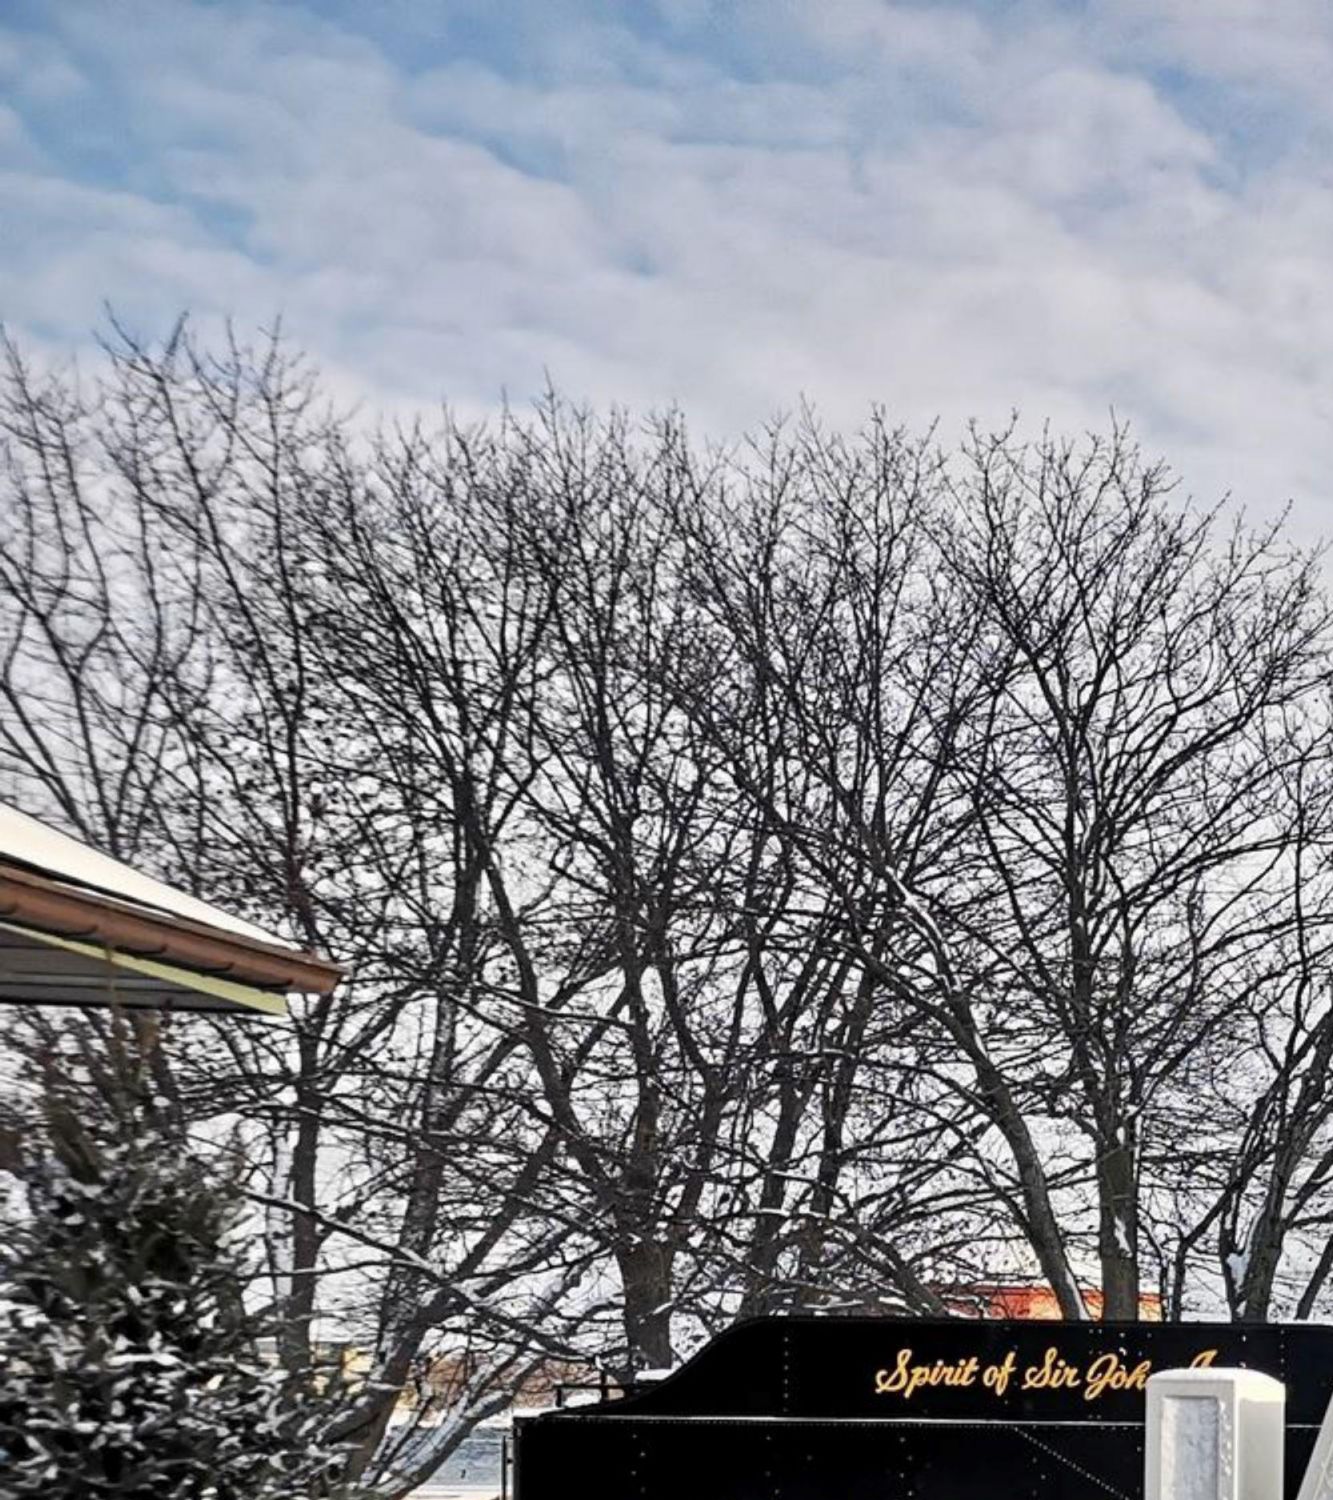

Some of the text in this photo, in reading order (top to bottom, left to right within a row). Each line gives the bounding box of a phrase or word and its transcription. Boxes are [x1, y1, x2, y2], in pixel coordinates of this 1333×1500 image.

[875, 1349, 979, 1399] Spirit
[983, 1350, 1017, 1396] of
[1022, 1346, 1081, 1391] Sir
[1084, 1353, 1152, 1400] Joh
